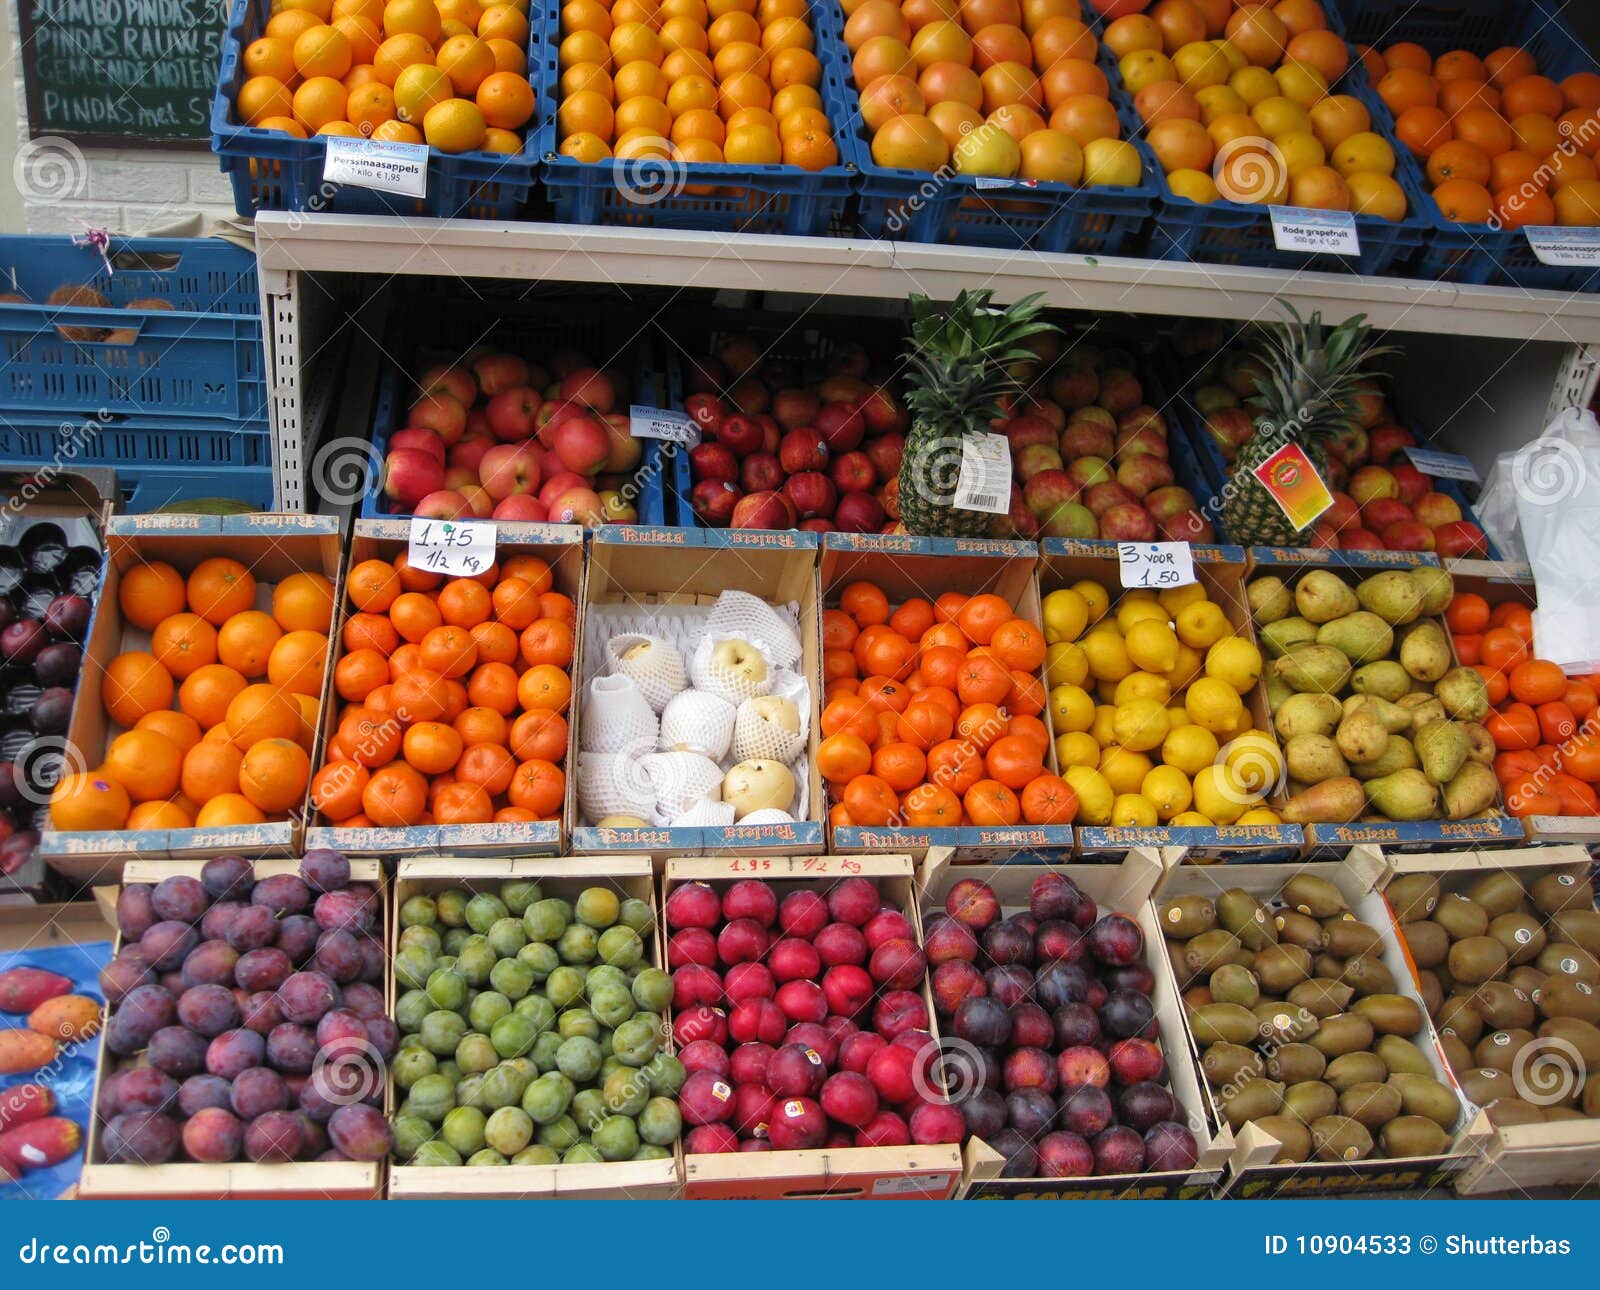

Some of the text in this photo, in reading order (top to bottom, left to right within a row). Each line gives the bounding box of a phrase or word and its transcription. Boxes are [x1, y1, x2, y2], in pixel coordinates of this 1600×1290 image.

[1282, 226, 1349, 239] Rode grapefruit
[415, 523, 474, 548] 1.75
[426, 550, 450, 569] 1/2
[1121, 545, 1140, 563] 3
[1138, 568, 1180, 587] 1.50
[729, 859, 771, 872] 1.95
